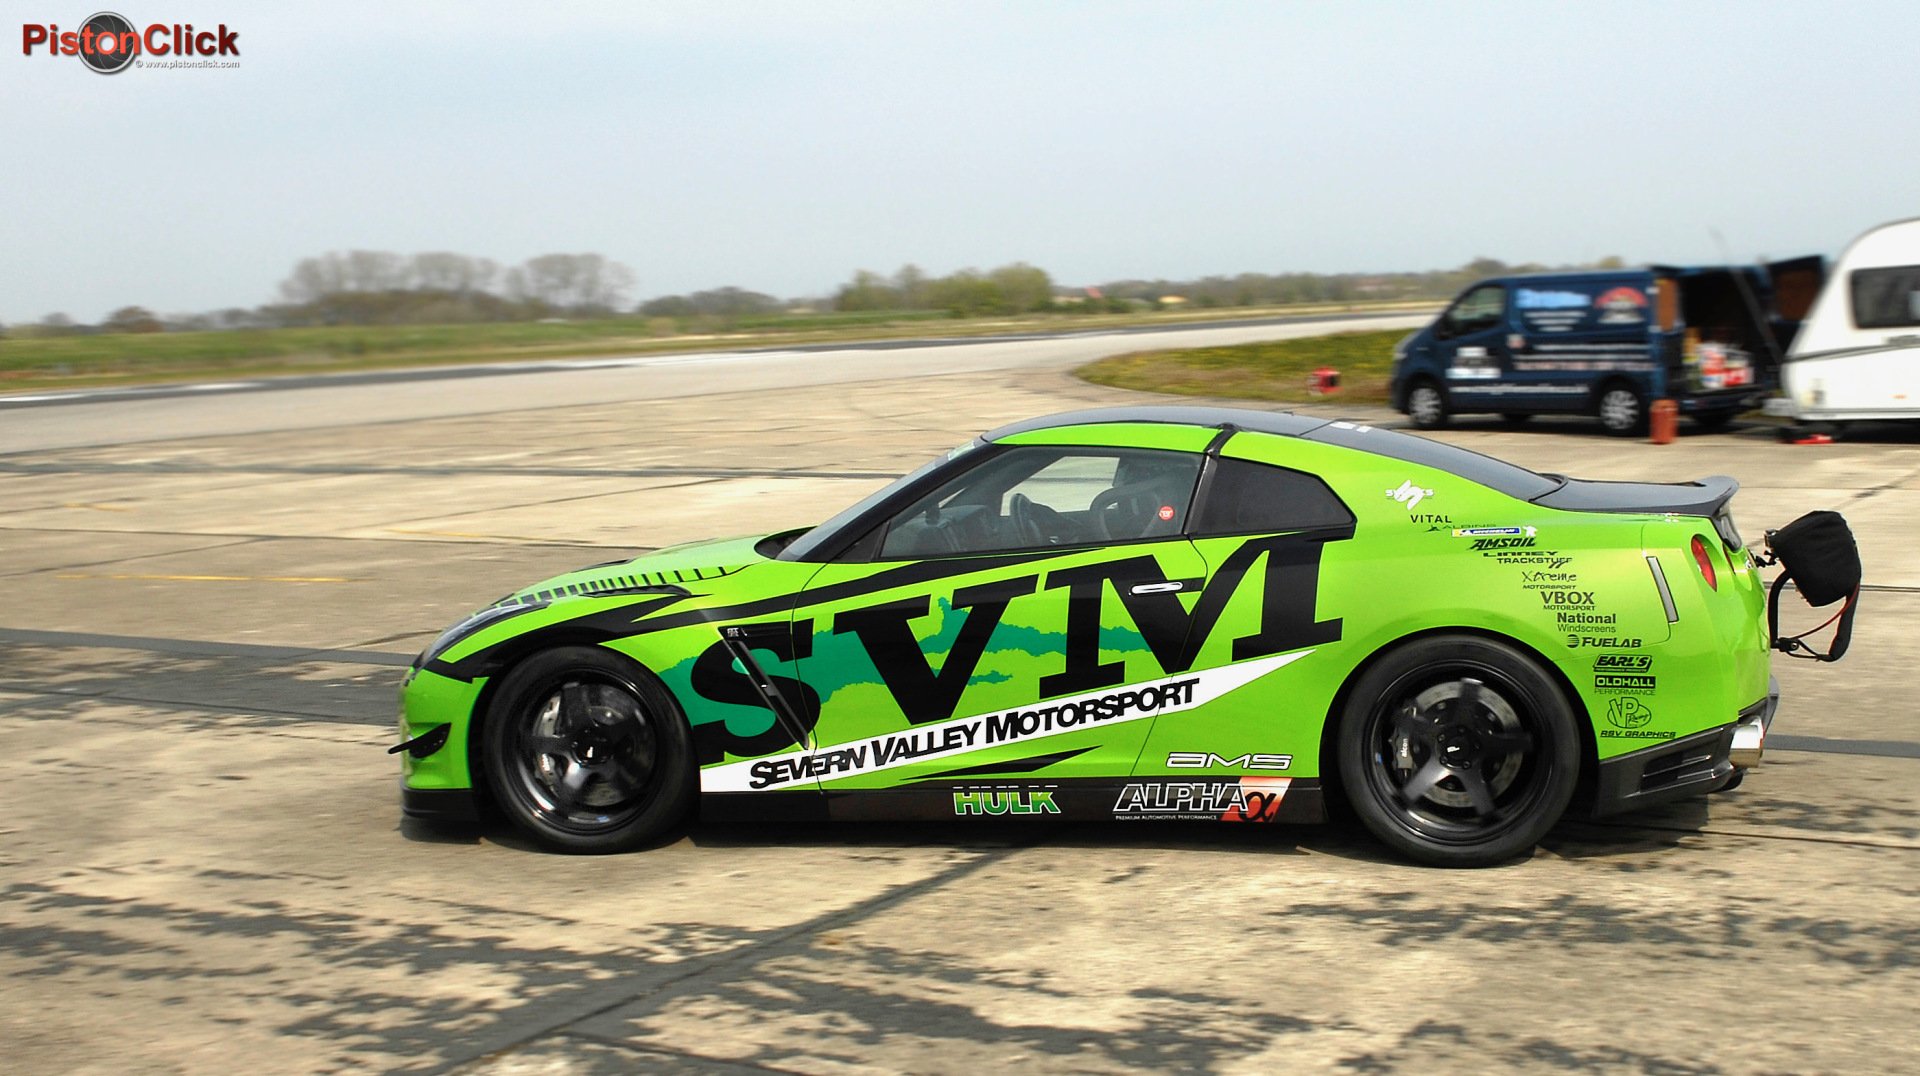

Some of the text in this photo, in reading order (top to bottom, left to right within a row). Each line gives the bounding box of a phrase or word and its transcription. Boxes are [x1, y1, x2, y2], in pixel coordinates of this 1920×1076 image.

[1410, 514, 1453, 524] VITAL
[1468, 537, 1537, 551] AMSOIL
[1497, 557, 1573, 568] TRACKSTUFF
[1540, 591, 1595, 605] VBOX
[1557, 612, 1617, 624] National
[1557, 624, 1617, 633] Windscreens
[1581, 636, 1642, 648] FUELAB
[690, 533, 1343, 764] SVM
[1596, 655, 1650, 668] EARL'S
[1596, 677, 1655, 687] OLDHALL
[1595, 688, 1656, 696] PERFORMANCE
[749, 678, 1201, 790] SEVERN VALLEY MOTORSPORT
[1600, 730, 1677, 739] RSV GRAPHICS
[952, 785, 1061, 815] HULK
[1112, 783, 1249, 812] ALPHA
